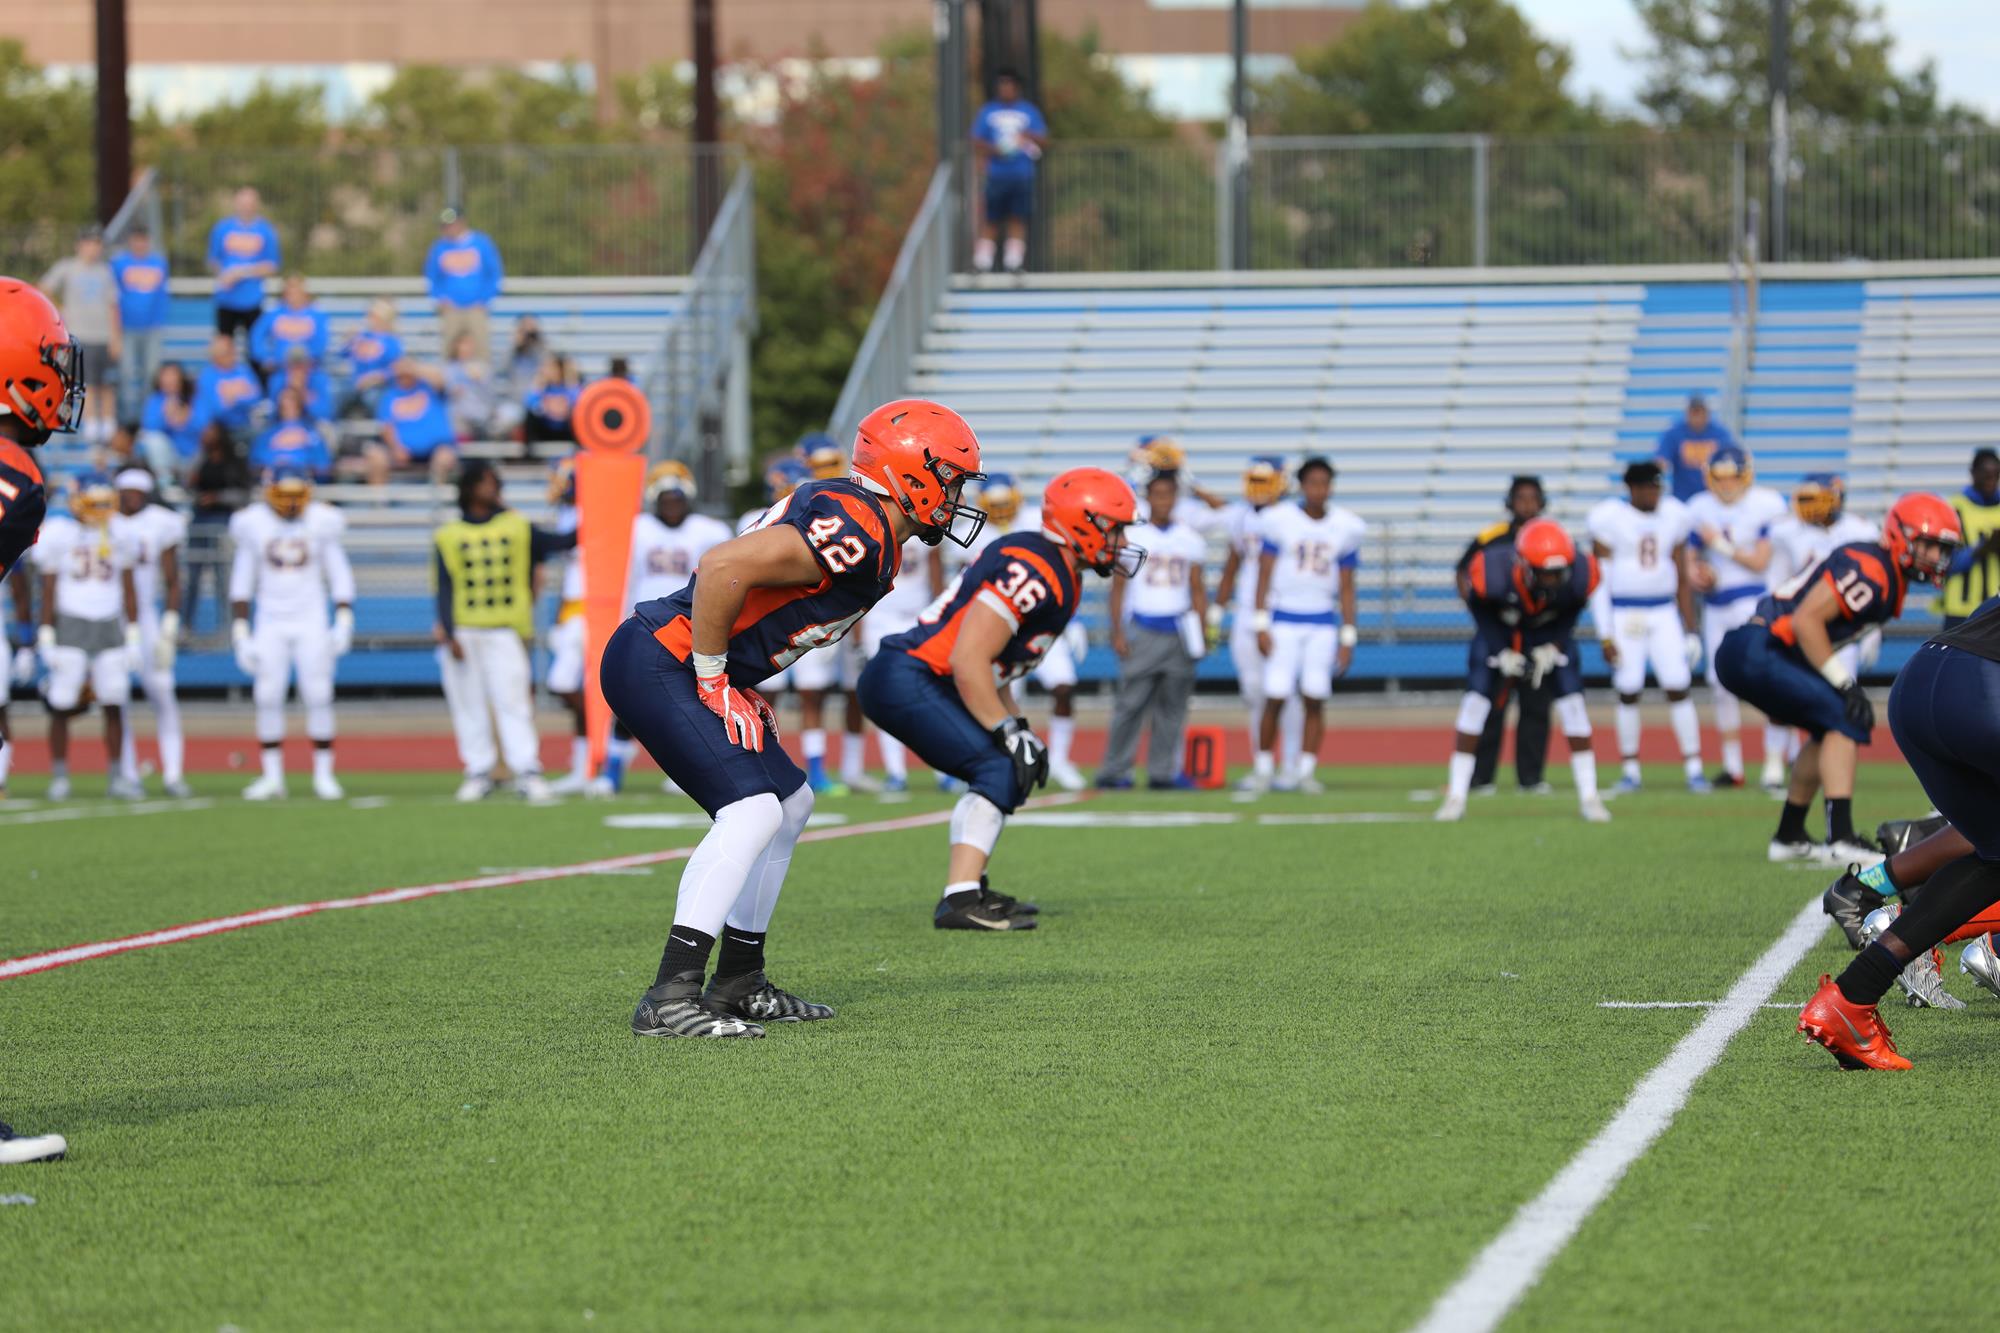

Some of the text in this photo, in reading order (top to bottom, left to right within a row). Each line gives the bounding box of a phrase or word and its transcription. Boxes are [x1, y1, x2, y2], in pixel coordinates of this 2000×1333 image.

[806, 515, 866, 573] 42
[995, 562, 1046, 613] 36
[1836, 569, 1873, 612] 10
